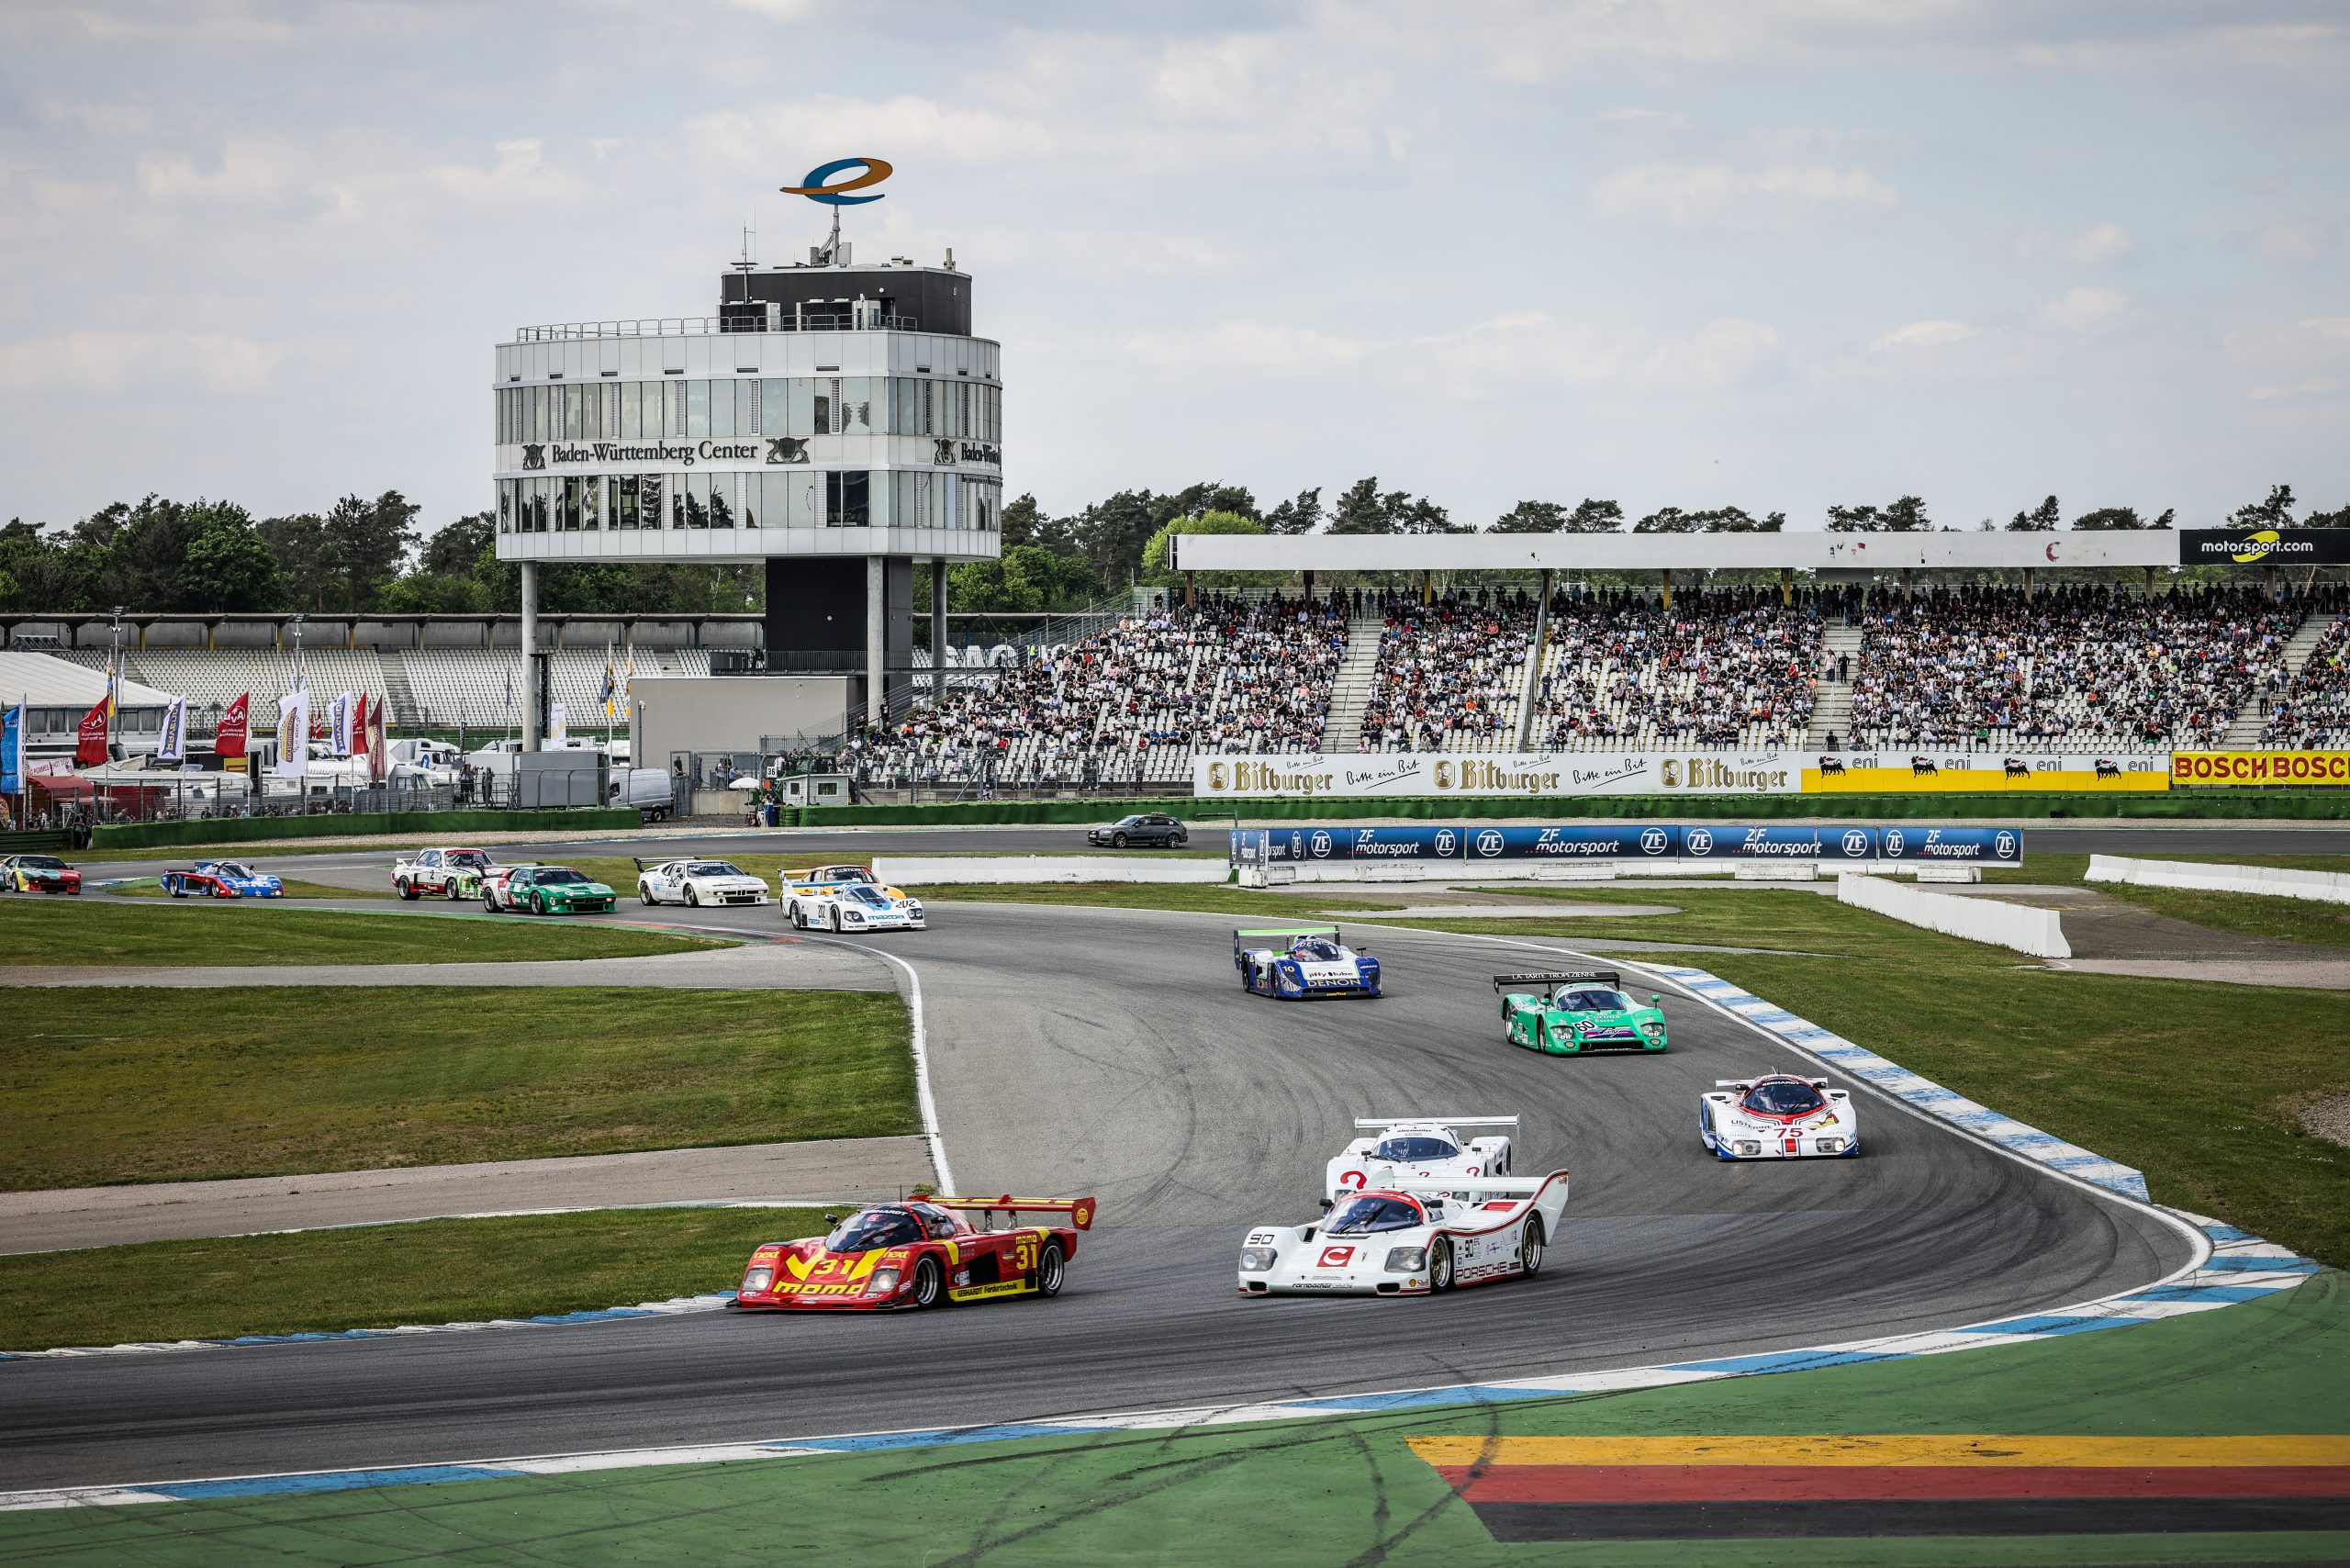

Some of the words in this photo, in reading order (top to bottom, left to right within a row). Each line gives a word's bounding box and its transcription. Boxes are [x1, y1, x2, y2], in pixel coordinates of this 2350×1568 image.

[552, 440, 696, 465] Baden-Württemberg
[699, 440, 758, 460] Center
[2201, 540, 2313, 555] motorsport.com
[1605, 767, 1622, 777] ein
[1624, 758, 1647, 772] Bit
[1852, 753, 1878, 768] eni
[1944, 755, 1971, 769] eni
[2037, 756, 2062, 771] eni
[2128, 756, 2154, 771] eni
[2175, 756, 2268, 778] BOSCH
[2273, 756, 2350, 778] BOSC
[767, 767, 776, 776] 36
[1378, 769, 1394, 778] ein
[1398, 759, 1421, 773] Bit
[1686, 757, 1787, 791] Bitburger
[1233, 760, 1334, 795] Bitburger
[1460, 759, 1561, 794] Bitburger
[1358, 829, 1374, 843] ZF
[1539, 828, 1561, 843] ZF
[1745, 828, 1767, 842] ZF
[1927, 829, 1941, 843] ZF
[1269, 844, 1285, 857] orsport
[1356, 842, 1419, 857] motorsport
[1536, 840, 1619, 855] motorsport
[1742, 841, 1822, 857] motorsport
[1924, 842, 1980, 857] motorsport
[896, 900, 916, 909] 202
[1307, 979, 1361, 987] DENON
[1574, 1020, 1595, 1032] 60
[1774, 1127, 1804, 1138] 75
[1015, 1235, 1037, 1244] momo
[1248, 1234, 1275, 1245] 90
[884, 1250, 910, 1259] next
[1016, 1244, 1037, 1270] 31
[813, 1259, 856, 1276] 31
[1455, 1260, 1507, 1282] PORSCHE
[772, 1281, 867, 1294] momo
